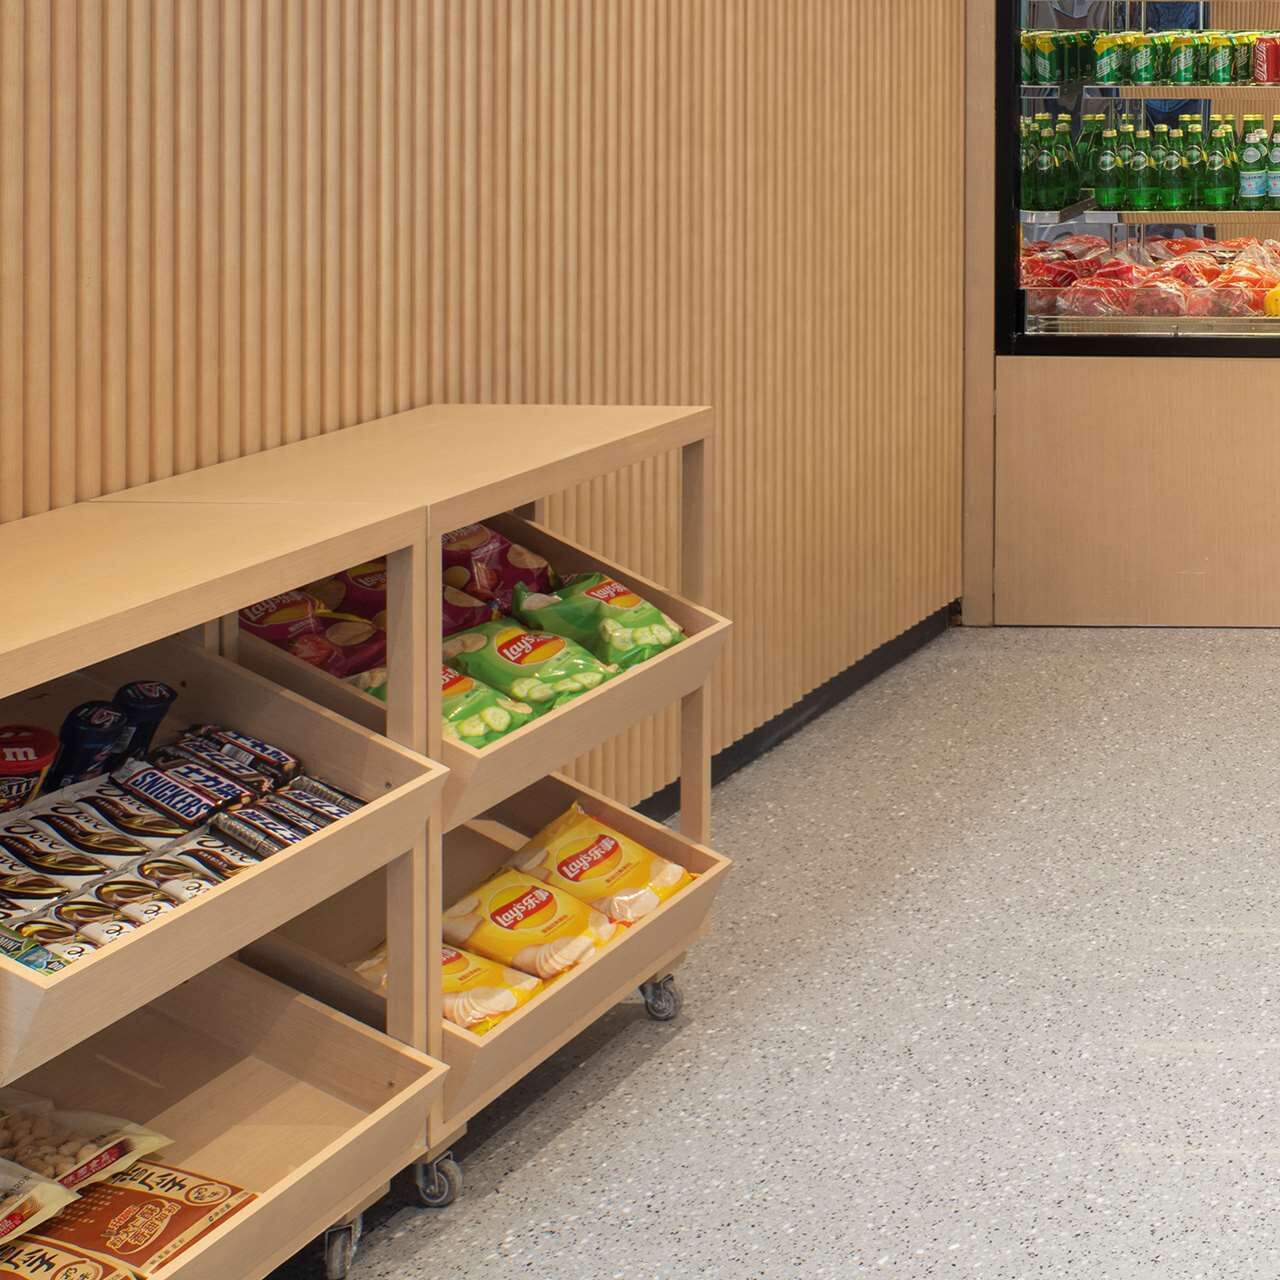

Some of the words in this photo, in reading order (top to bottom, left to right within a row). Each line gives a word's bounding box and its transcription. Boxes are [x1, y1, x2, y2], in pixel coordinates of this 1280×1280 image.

[131, 770, 209, 819] SNICKERS
[561, 836, 617, 880] Lay's乐事
[497, 885, 551, 928] Lay's乐事
